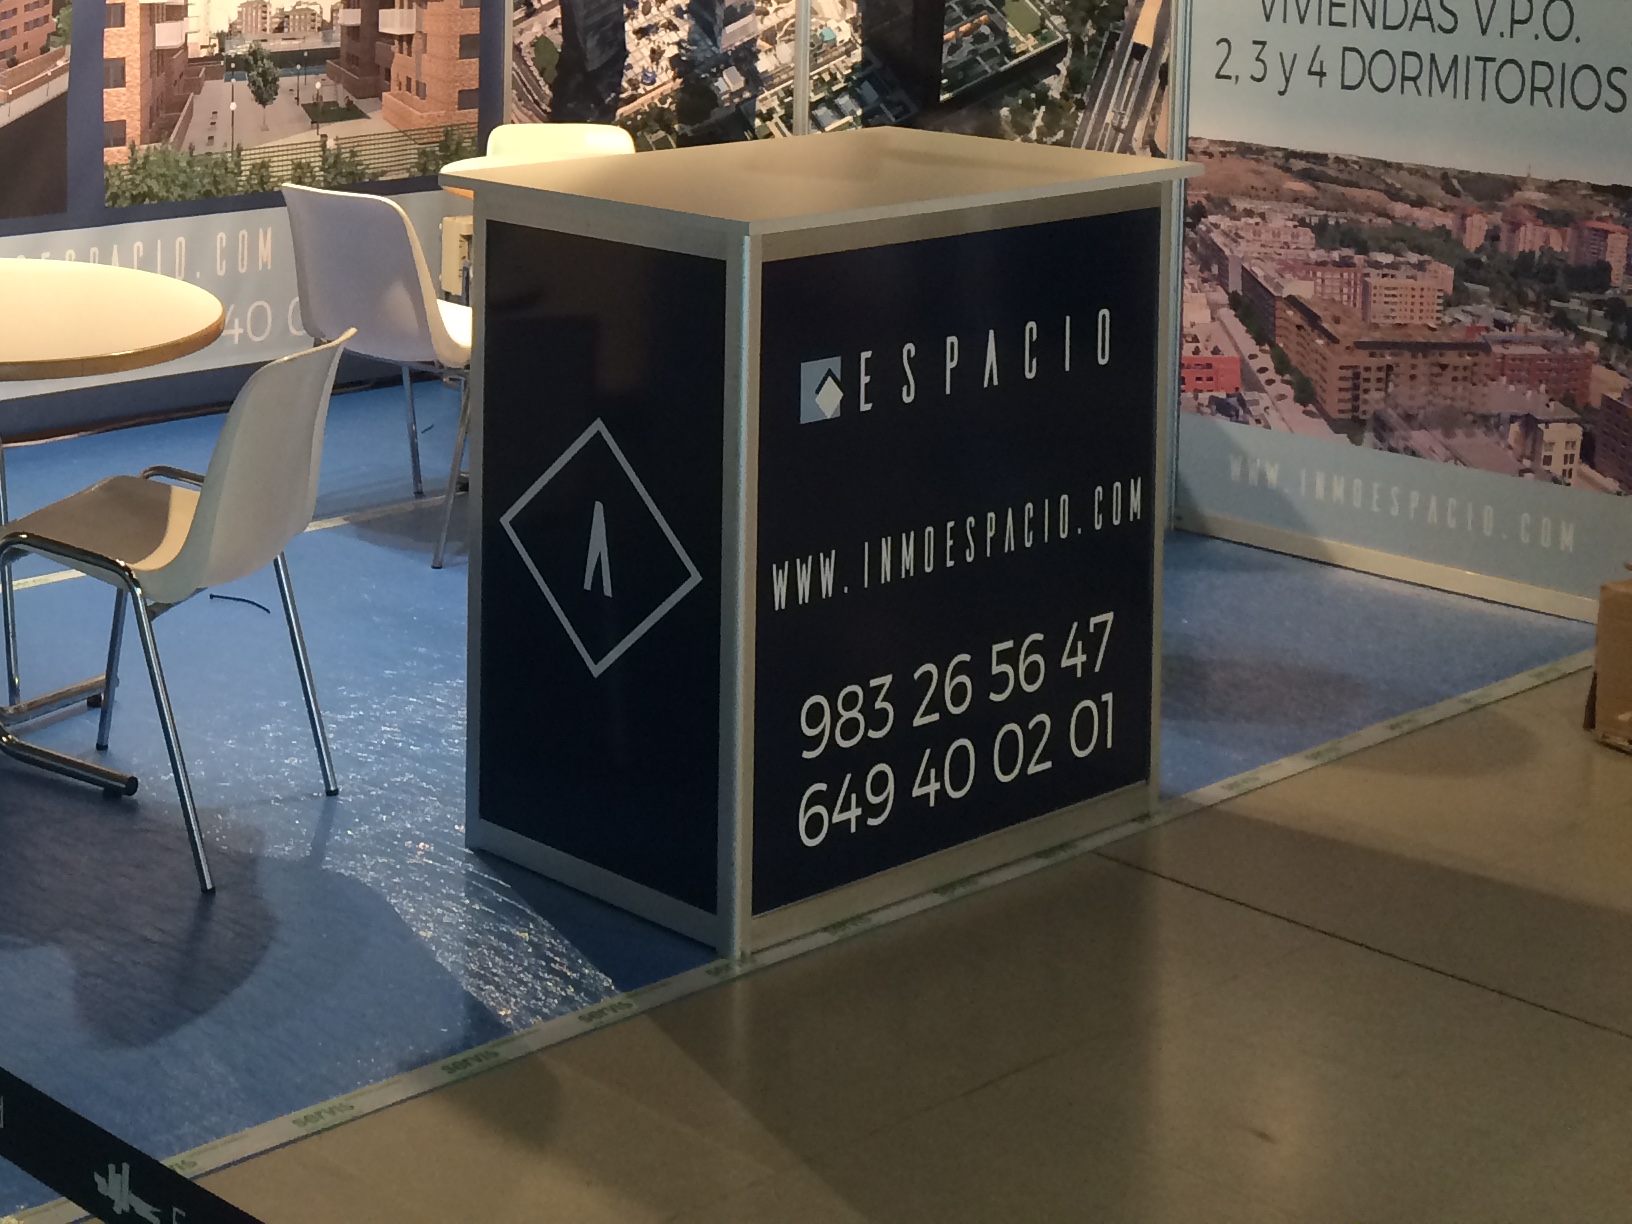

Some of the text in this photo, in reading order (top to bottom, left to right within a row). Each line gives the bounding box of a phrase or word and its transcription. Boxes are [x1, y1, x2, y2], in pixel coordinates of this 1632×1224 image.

[1214, 37, 1629, 114] 2, 3 y 4 DORMITORIOS
[859, 308, 1111, 412] ESPACIO
[772, 476, 1143, 611] WWW.INMOESPACIO.COM
[800, 612, 1114, 759] 983 26 56 47
[798, 692, 1114, 847] 649 40 02 01
